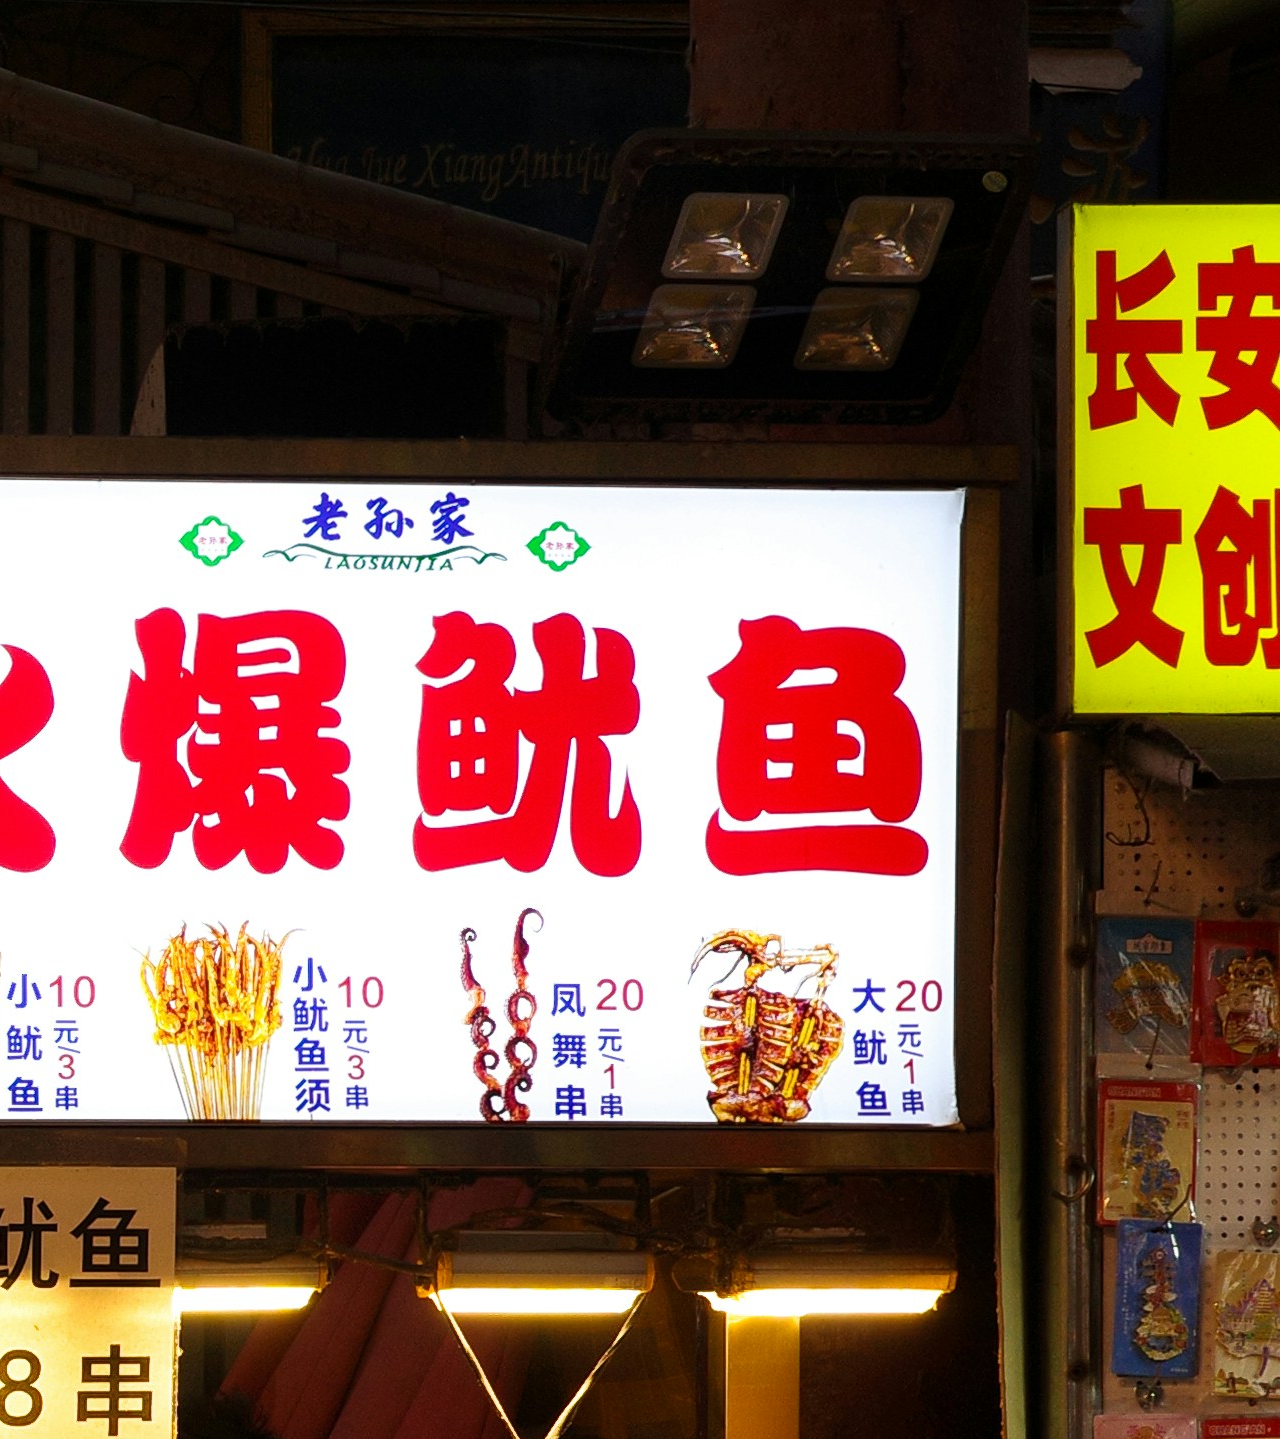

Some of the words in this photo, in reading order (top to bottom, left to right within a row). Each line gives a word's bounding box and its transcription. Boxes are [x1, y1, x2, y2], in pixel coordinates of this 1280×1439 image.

[1088, 247, 1280, 429] 长安
[302, 491, 474, 545] 老孙家
[322, 554, 455, 573] LAOSUNJIA
[50, 975, 96, 1008] 10
[337, 976, 384, 1009] 10
[596, 978, 646, 1012] 20
[895, 979, 943, 1012] 20
[6, 973, 43, 1113] 小鱿鱼
[293, 957, 331, 1114] 小鱿鱼须
[852, 978, 891, 1117] 大鱿鱼
